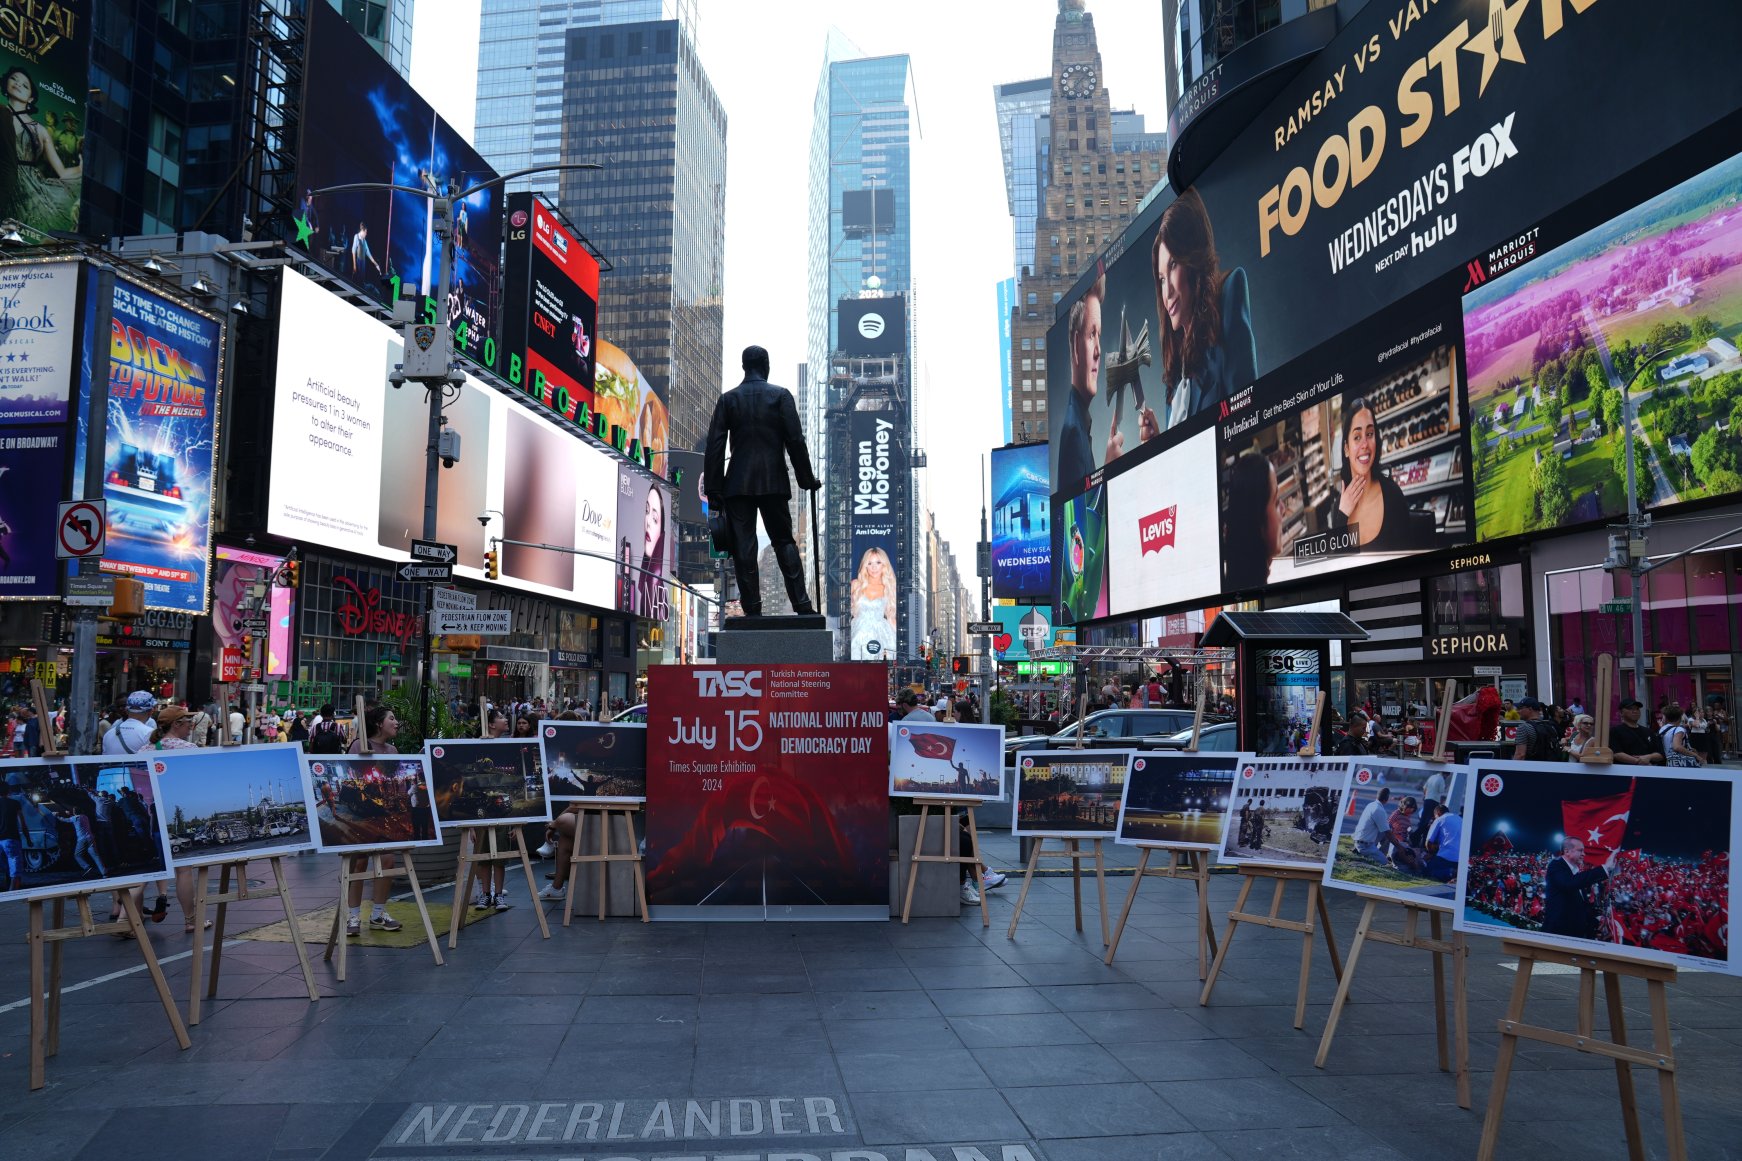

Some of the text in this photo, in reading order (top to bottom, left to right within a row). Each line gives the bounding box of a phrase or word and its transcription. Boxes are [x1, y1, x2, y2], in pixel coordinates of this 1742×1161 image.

[39, 81, 77, 104] NOBLEZADA
[52, 82, 65, 92] EVA
[1178, 63, 1224, 112] MARRIOTT
[1274, 64, 1347, 151] RAMSAY
[1353, 34, 1382, 74] VS
[1179, 84, 1217, 127] MARQUIS
[1258, 104, 1387, 258] FOOD
[1328, 111, 1519, 274] WEDNESDAYS FOX
[510, 230, 526, 241] LG
[1374, 213, 1457, 274] NEXT DAY hulu
[1489, 227, 1540, 262] MARRIOTT
[1489, 244, 1535, 275] MARQUIS
[859, 289, 884, 299] 2024
[113, 286, 201, 332] IT'S TIME TO CHANGE
[465, 305, 486, 328] WATER
[139, 310, 177, 333] THEATER
[178, 327, 212, 348] HISTORY
[534, 311, 556, 338] CNET
[110, 317, 192, 381] BACK
[1377, 323, 1442, 363] @hydrafacial #hydrafacial
[109, 360, 131, 382] TO
[128, 369, 206, 407] FUTURE
[306, 377, 360, 412] Artificial beauty
[1230, 386, 1254, 403] MARRIOTT
[153, 404, 203, 416] THE MUSICAL
[292, 390, 328, 413] pressures
[333, 406, 340, 417] in
[341, 409, 346, 420] 3
[346, 414, 371, 430] women
[1223, 372, 1345, 442] Hydrafacial Get the Best Skin of Your Life.
[1230, 397, 1251, 412] MARQUIS
[311, 414, 353, 440] to alter their
[6, 436, 58, 449] ON BROADWAY!
[308, 433, 354, 457] appearance.
[871, 418, 893, 515] Moroney
[854, 441, 877, 515] Megan
[582, 499, 602, 527] Dove
[417, 546, 451, 559] ONE WAY
[1297, 533, 1358, 558] HELLO GLOW
[118, 563, 147, 574] BETWEEN
[158, 569, 171, 577] AND
[404, 567, 445, 577] ONE WAY
[1450, 553, 1491, 570] SEPHORA
[437, 591, 457, 602] PEDESTRIAN
[644, 581, 670, 622] NARS
[132, 610, 193, 630] UGGAGE
[441, 613, 508, 622] PEDESTRIAN FLOW ZONE
[1607, 605, 1624, 613] W 46
[469, 623, 507, 632] KEEP MOVING
[1431, 633, 1509, 655] SEPHORA
[224, 655, 240, 664] MINI
[566, 653, 576, 662] POLO
[1263, 656, 1294, 671] TSQ
[504, 662, 529, 676] FOREVER
[693, 670, 830, 697] TASC Turkish American
[770, 680, 831, 689] National Steering
[770, 690, 809, 698] Committee
[769, 711, 884, 728] NATIONAL UNITY AND
[1381, 705, 1402, 716] MAKEUP
[668, 709, 763, 751] July 15
[781, 737, 872, 754] DEMOCRACY DAY
[669, 760, 756, 775] Times Square Exhibition
[702, 778, 722, 791] 2024
[395, 1096, 845, 1143] NEDERLANDER
